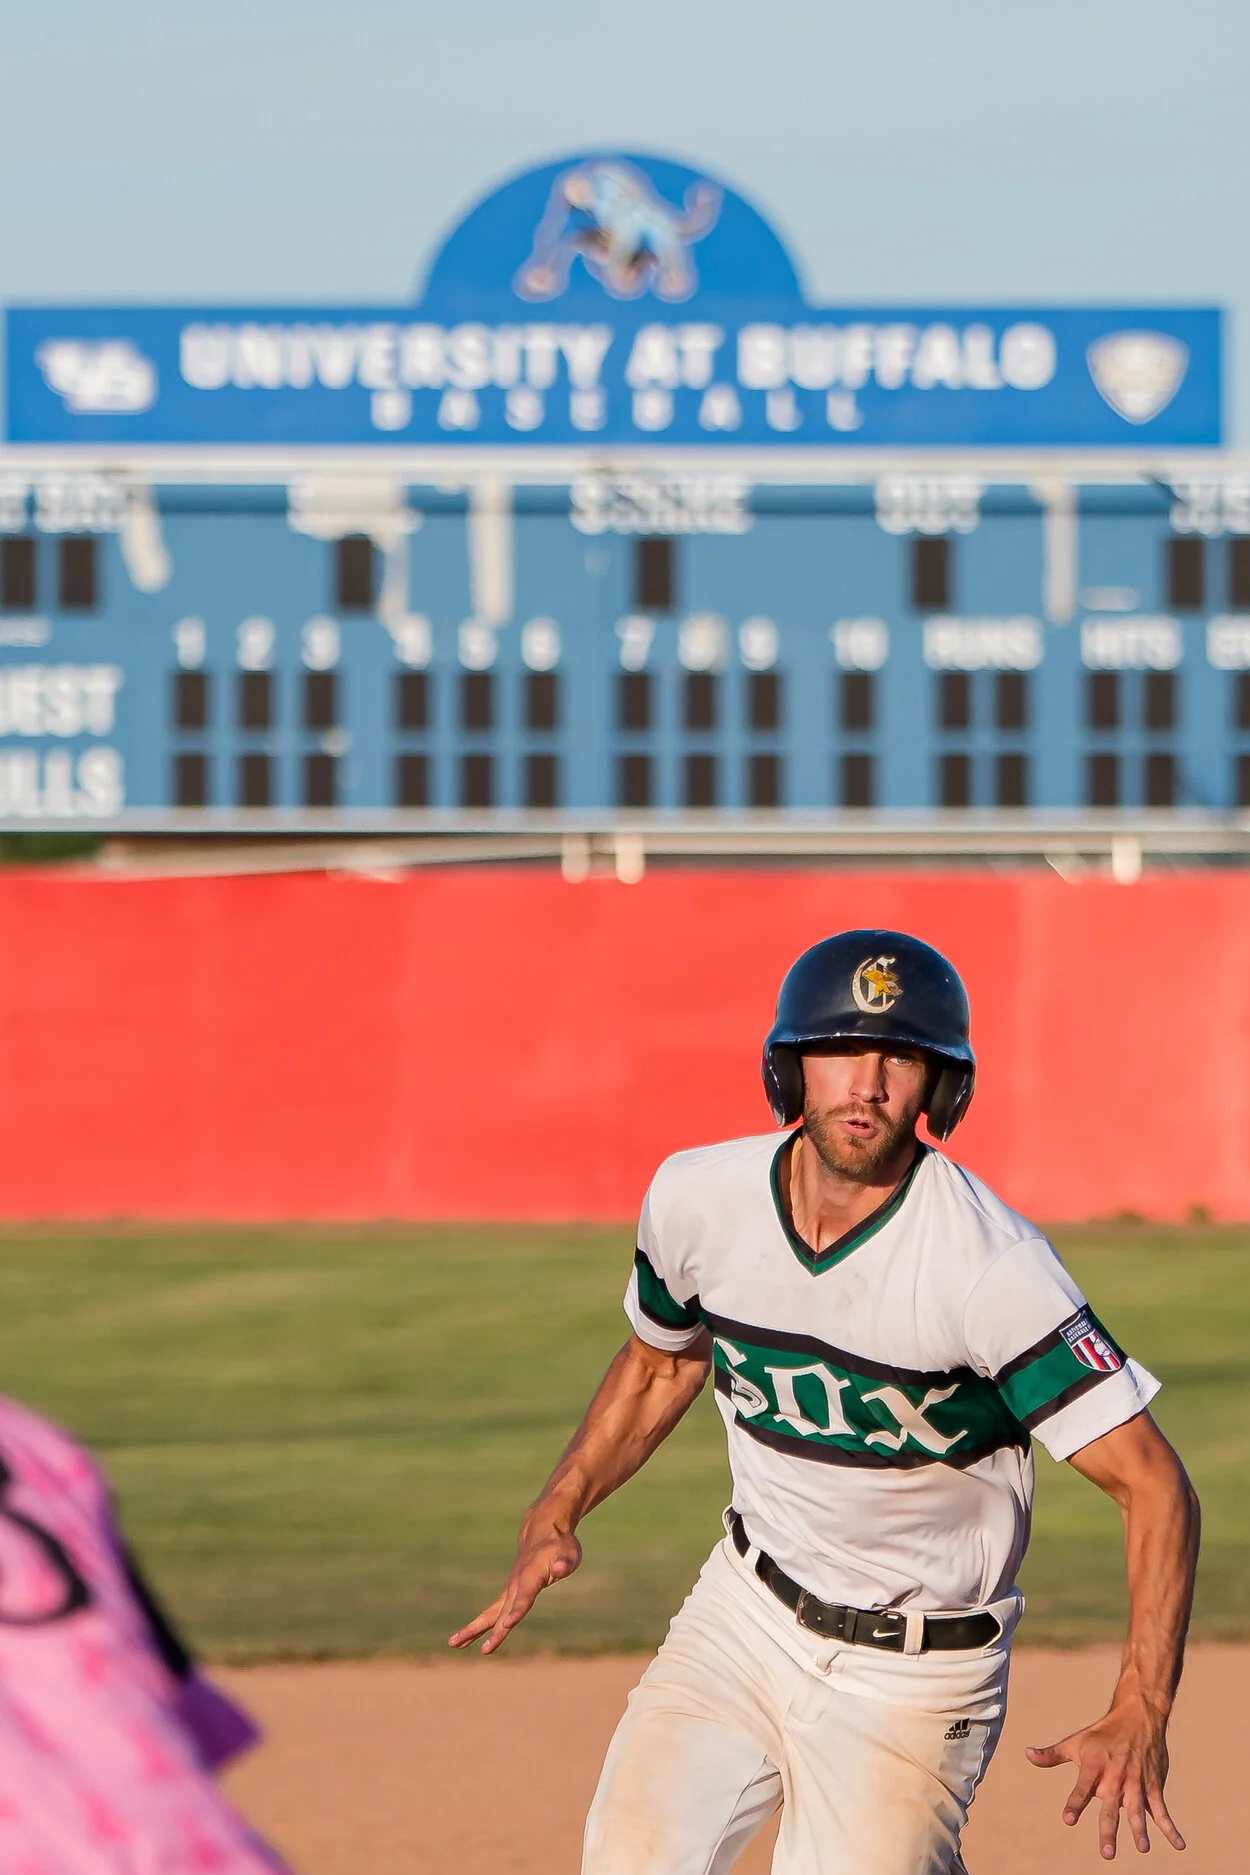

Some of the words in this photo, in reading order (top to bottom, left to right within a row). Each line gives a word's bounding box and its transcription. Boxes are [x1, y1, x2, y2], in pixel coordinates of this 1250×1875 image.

[180, 323, 612, 390] UNIVERSITY
[624, 323, 724, 389] AT
[737, 322, 1057, 390] BUFFALO
[173, 617, 206, 670] 1
[236, 617, 275, 670] 2
[616, 616, 656, 671] 7
[944, 1727, 972, 1740] adidas
